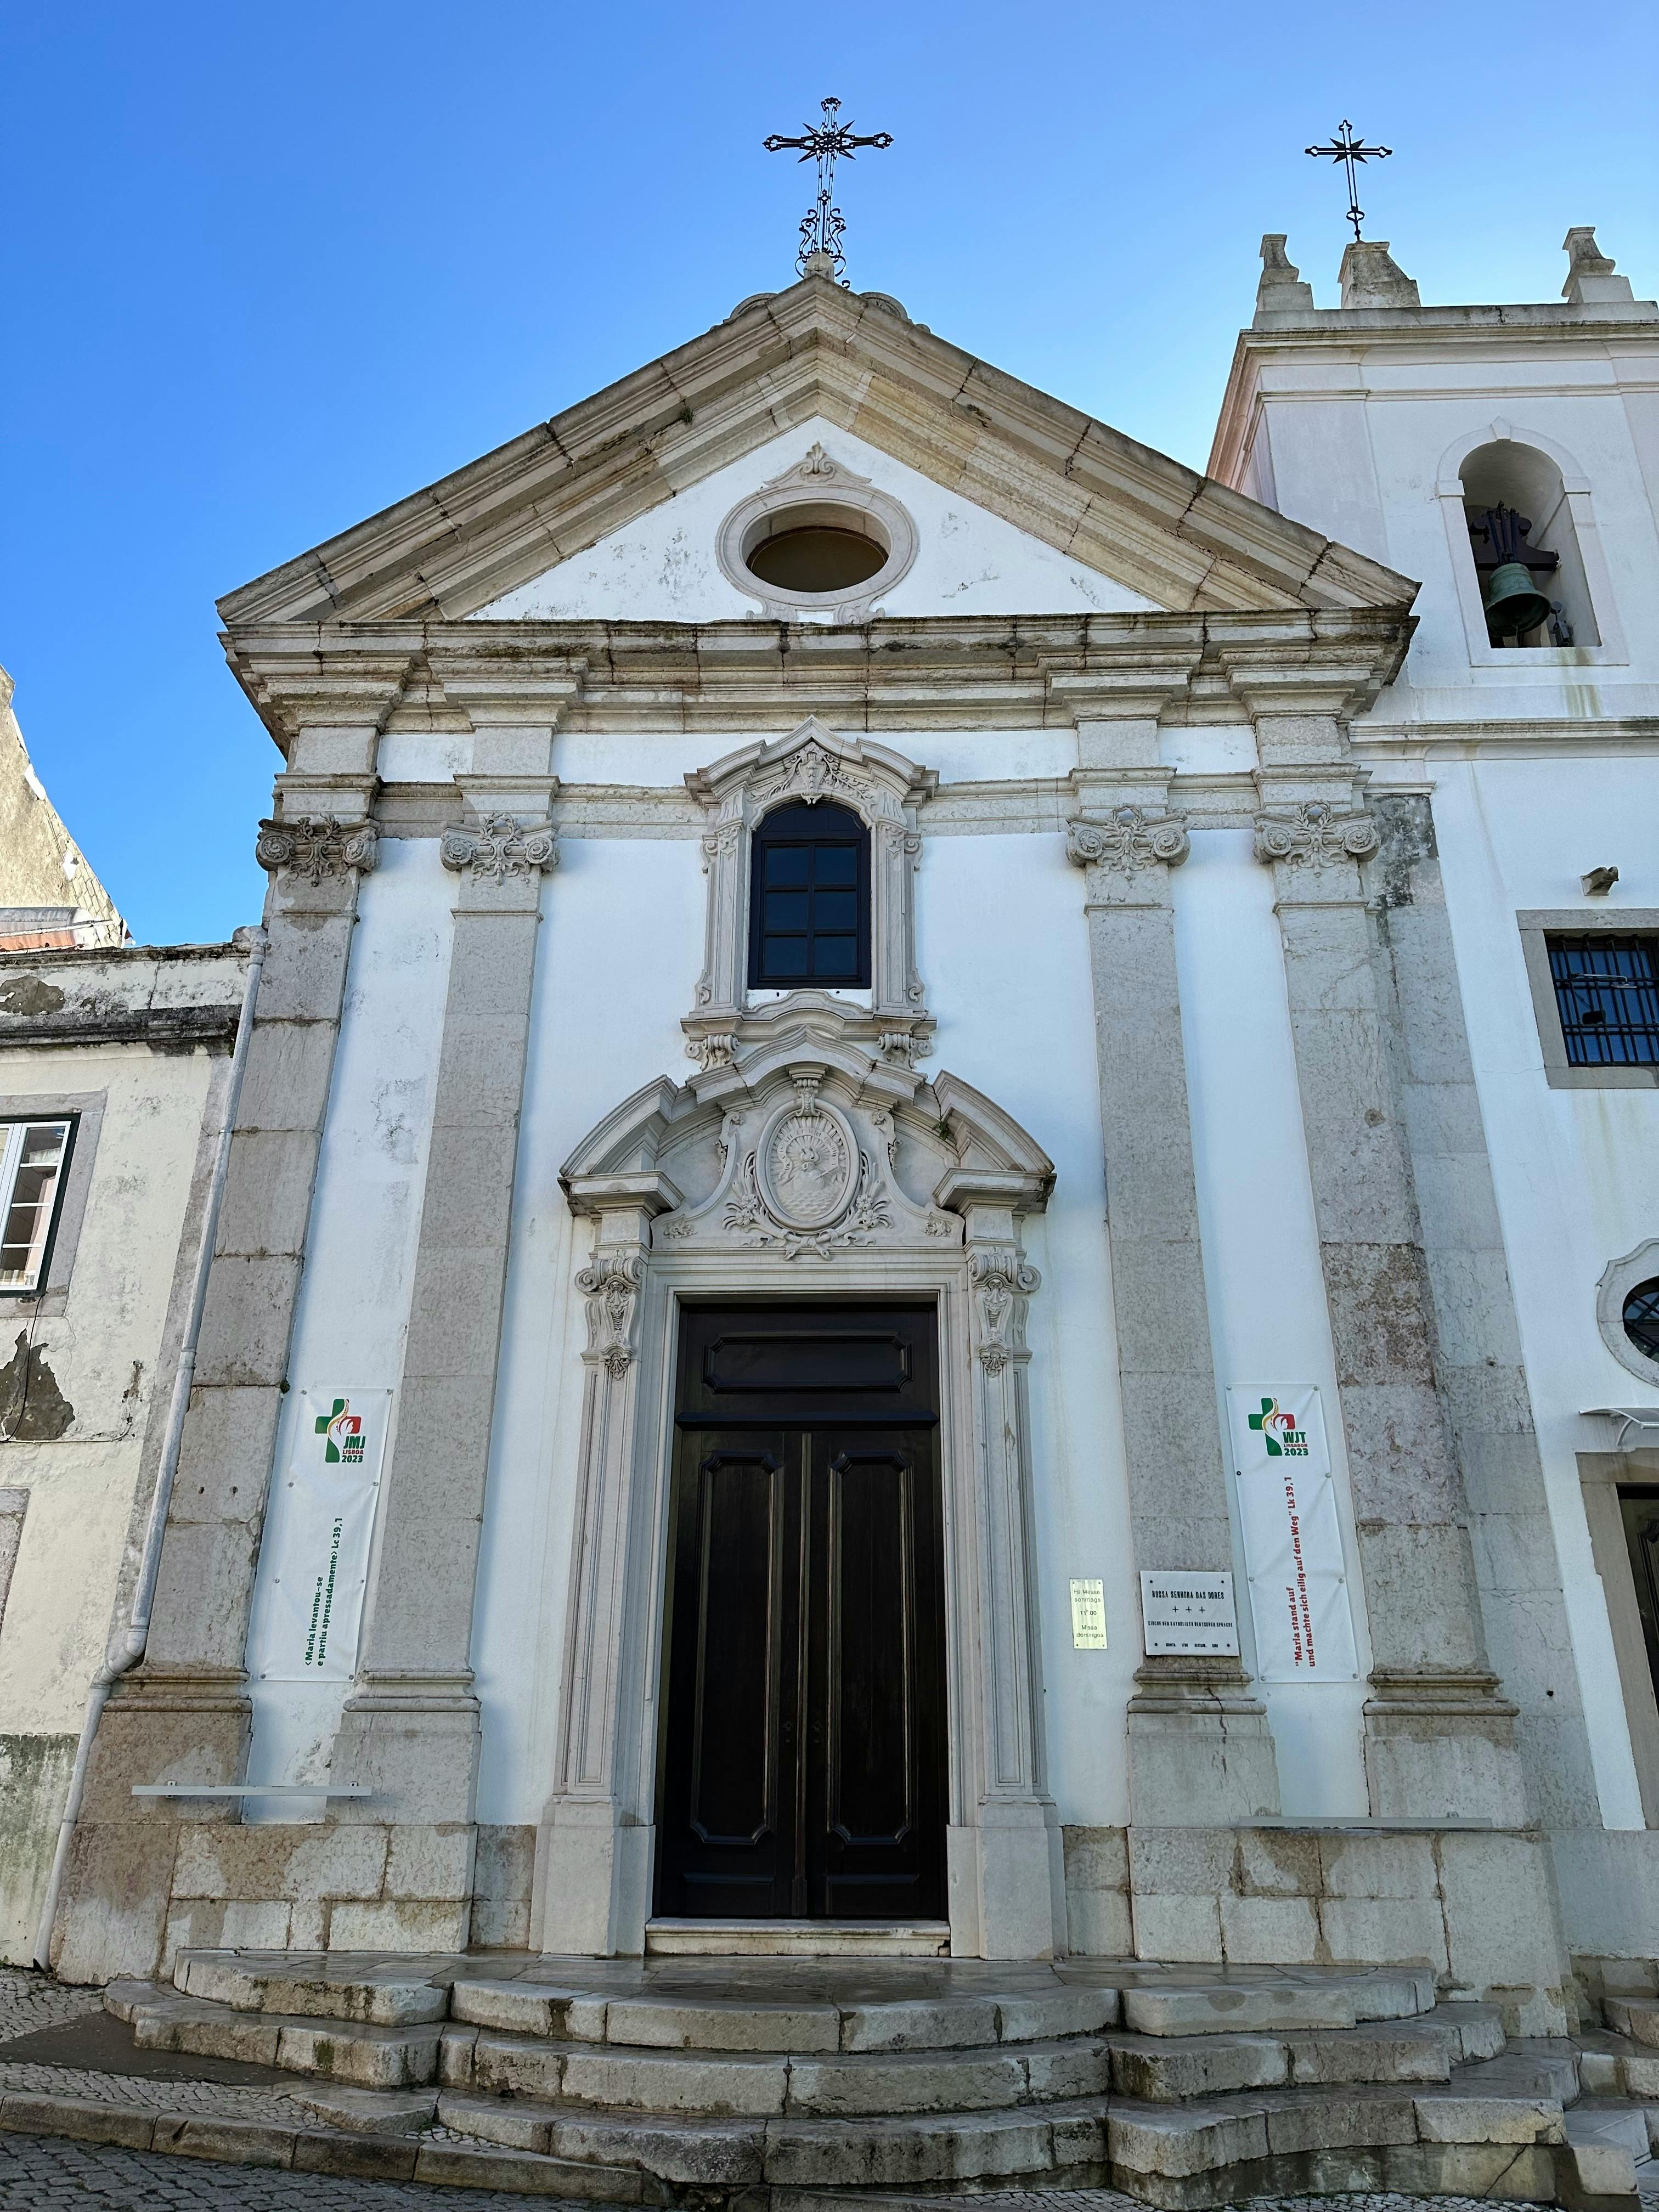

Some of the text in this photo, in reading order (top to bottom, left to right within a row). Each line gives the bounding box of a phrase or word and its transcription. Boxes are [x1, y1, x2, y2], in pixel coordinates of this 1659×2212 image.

[343, 1436, 366, 1449] JMJ
[1283, 1432, 1306, 1443] WJT
[1288, 1499, 1295, 1509] Lk
[1293, 1538, 1301, 1554] den
[1294, 1555, 1303, 1571] auf
[1297, 1573, 1306, 1592] eilig
[318, 1631, 327, 1658] partiu
[331, 1540, 339, 1548] Lc
[1286, 1587, 1295, 1602] auf
[1299, 1594, 1308, 1611] sich
[309, 1577, 323, 1631] levantou-se
[1289, 1605, 1299, 1630] stand
[1303, 1614, 1313, 1646] machte
[1306, 1649, 1315, 1667] und
